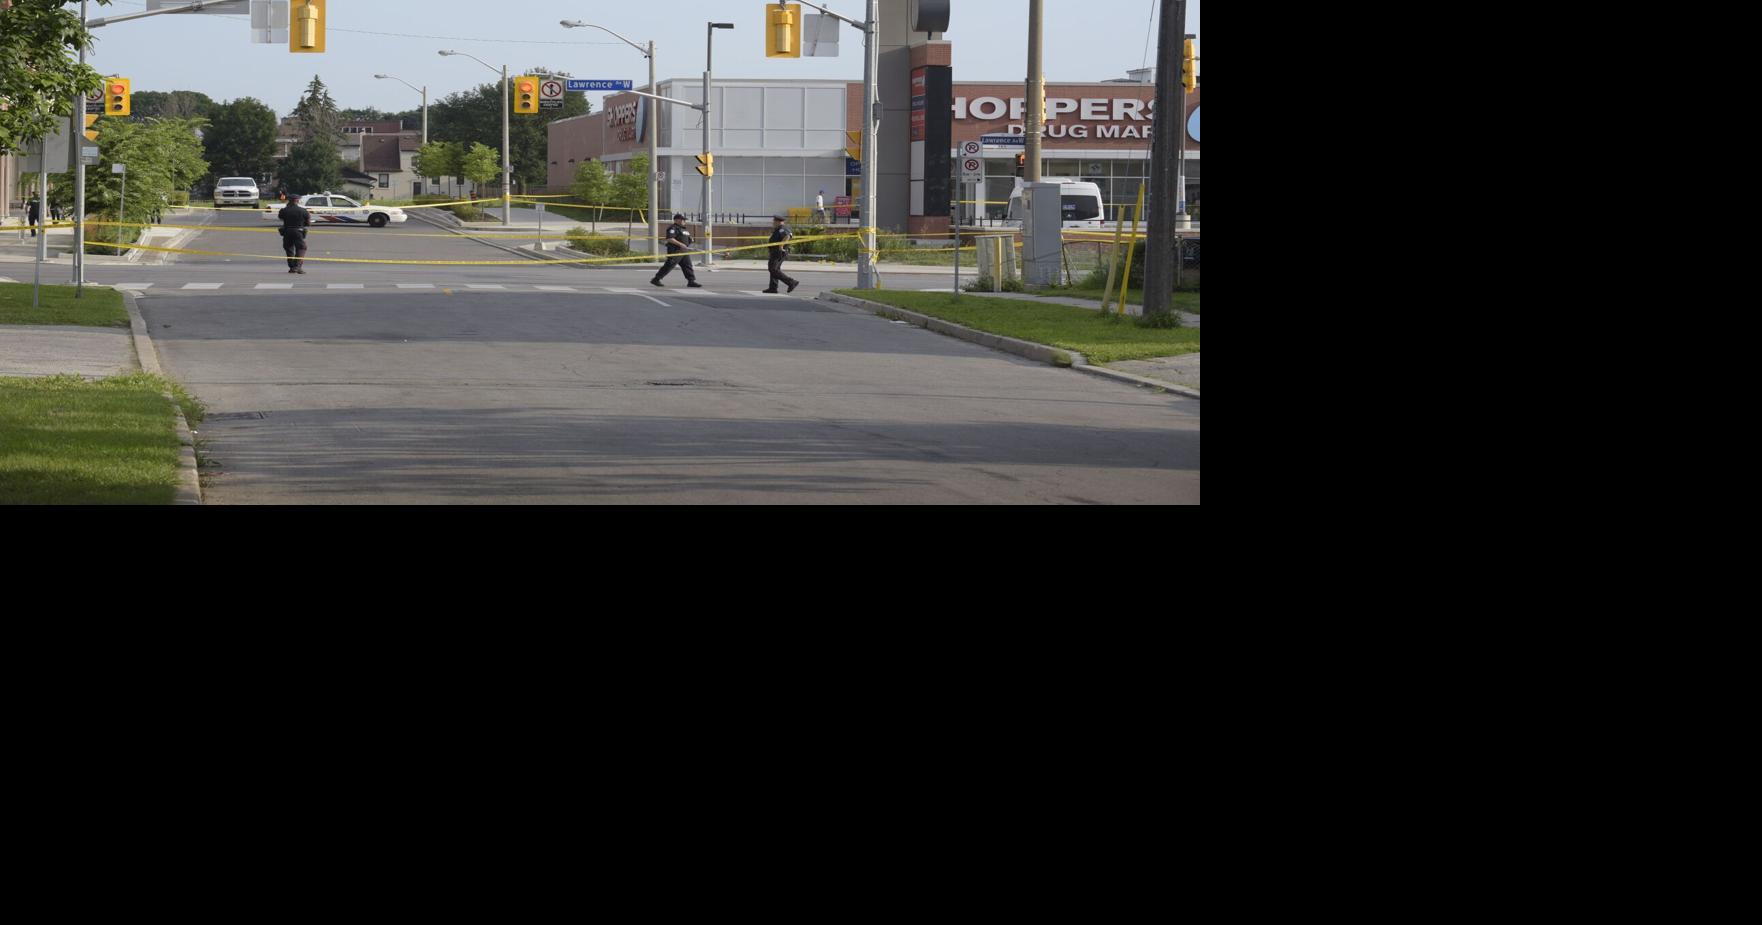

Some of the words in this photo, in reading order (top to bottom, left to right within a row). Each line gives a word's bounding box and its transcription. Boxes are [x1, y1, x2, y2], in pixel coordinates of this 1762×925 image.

[568, 80, 612, 89] Lawrence
[623, 80, 631, 88] W
[951, 96, 1154, 120] HOPPER
[1096, 124, 1153, 138] MAR
